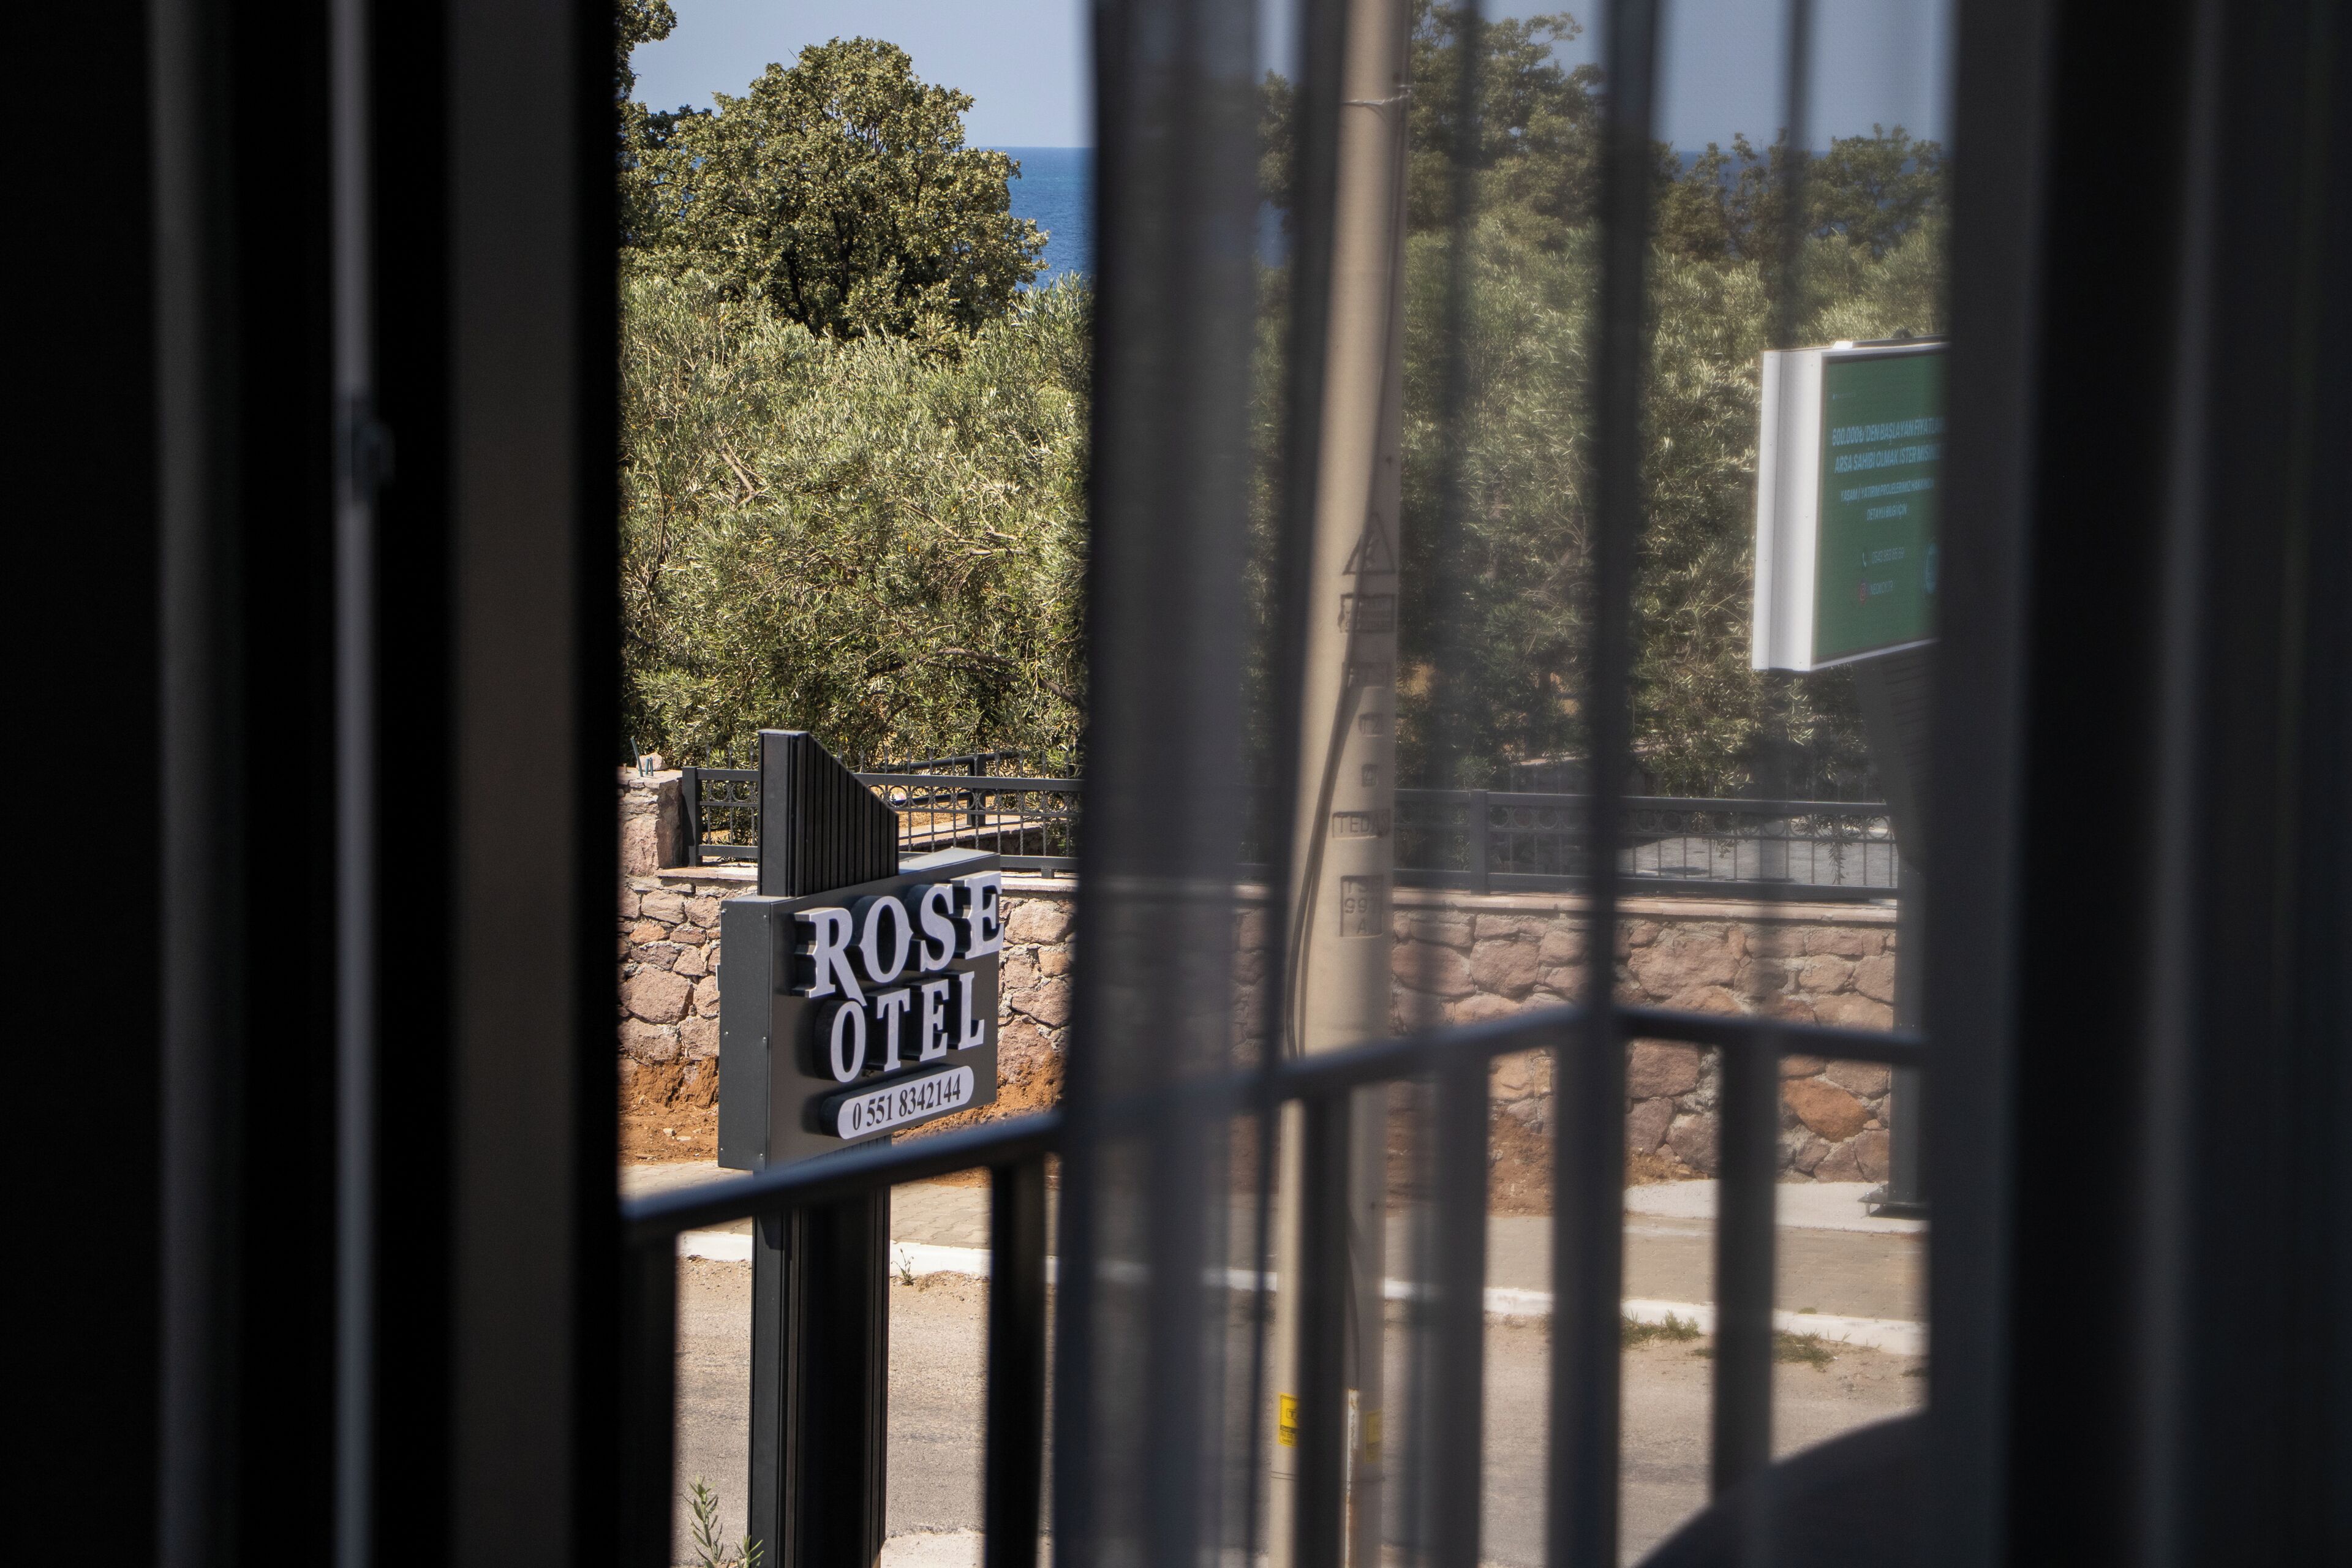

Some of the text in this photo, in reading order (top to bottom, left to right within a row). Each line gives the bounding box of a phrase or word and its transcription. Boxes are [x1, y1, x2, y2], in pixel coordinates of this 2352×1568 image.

[1834, 454, 1852, 474] ARSA
[1853, 447, 1875, 470] SAHİBİ
[1876, 448, 1898, 468] OLMAK
[1899, 443, 1917, 464] İSTER
[1880, 420, 1913, 445] BAŞLAYAN
[801, 870, 1005, 1006] ROSE
[828, 970, 984, 1083] OTEL
[852, 1073, 961, 1131] 0 551 8342144
